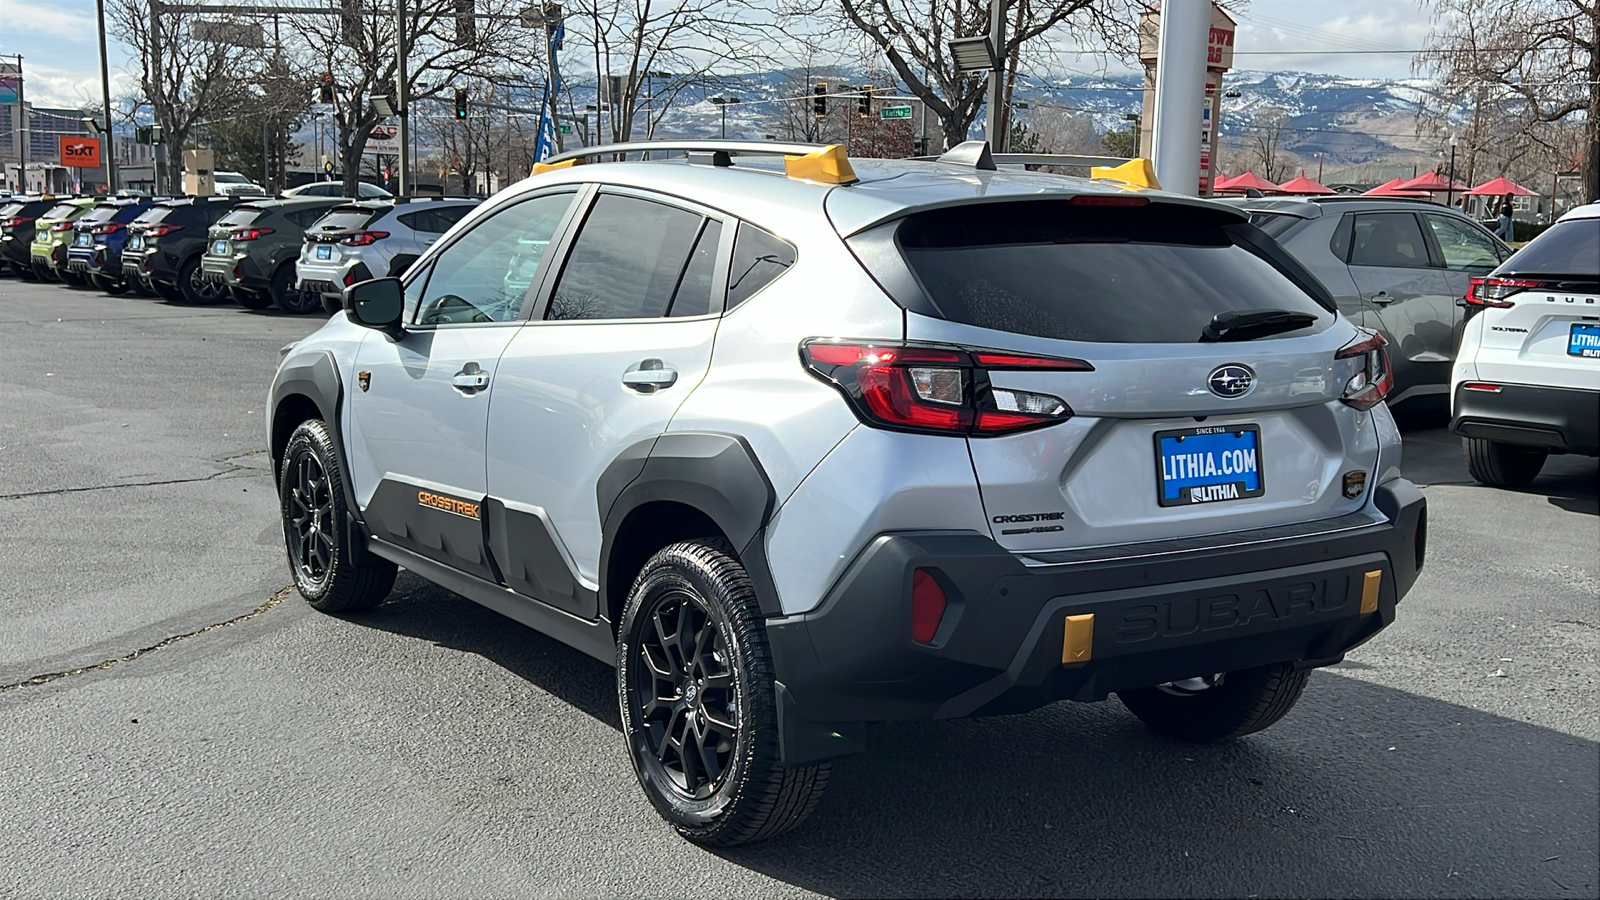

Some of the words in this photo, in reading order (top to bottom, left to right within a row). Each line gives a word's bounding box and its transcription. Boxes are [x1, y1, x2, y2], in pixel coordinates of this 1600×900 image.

[65, 143, 95, 157] SIXT
[1162, 448, 1257, 481] LITHIA.COM
[1201, 483, 1239, 502] LITHIA
[417, 491, 479, 518] CROSSTREK
[993, 512, 1065, 523] CROSSTREK
[1116, 574, 1351, 644] SUBARU
